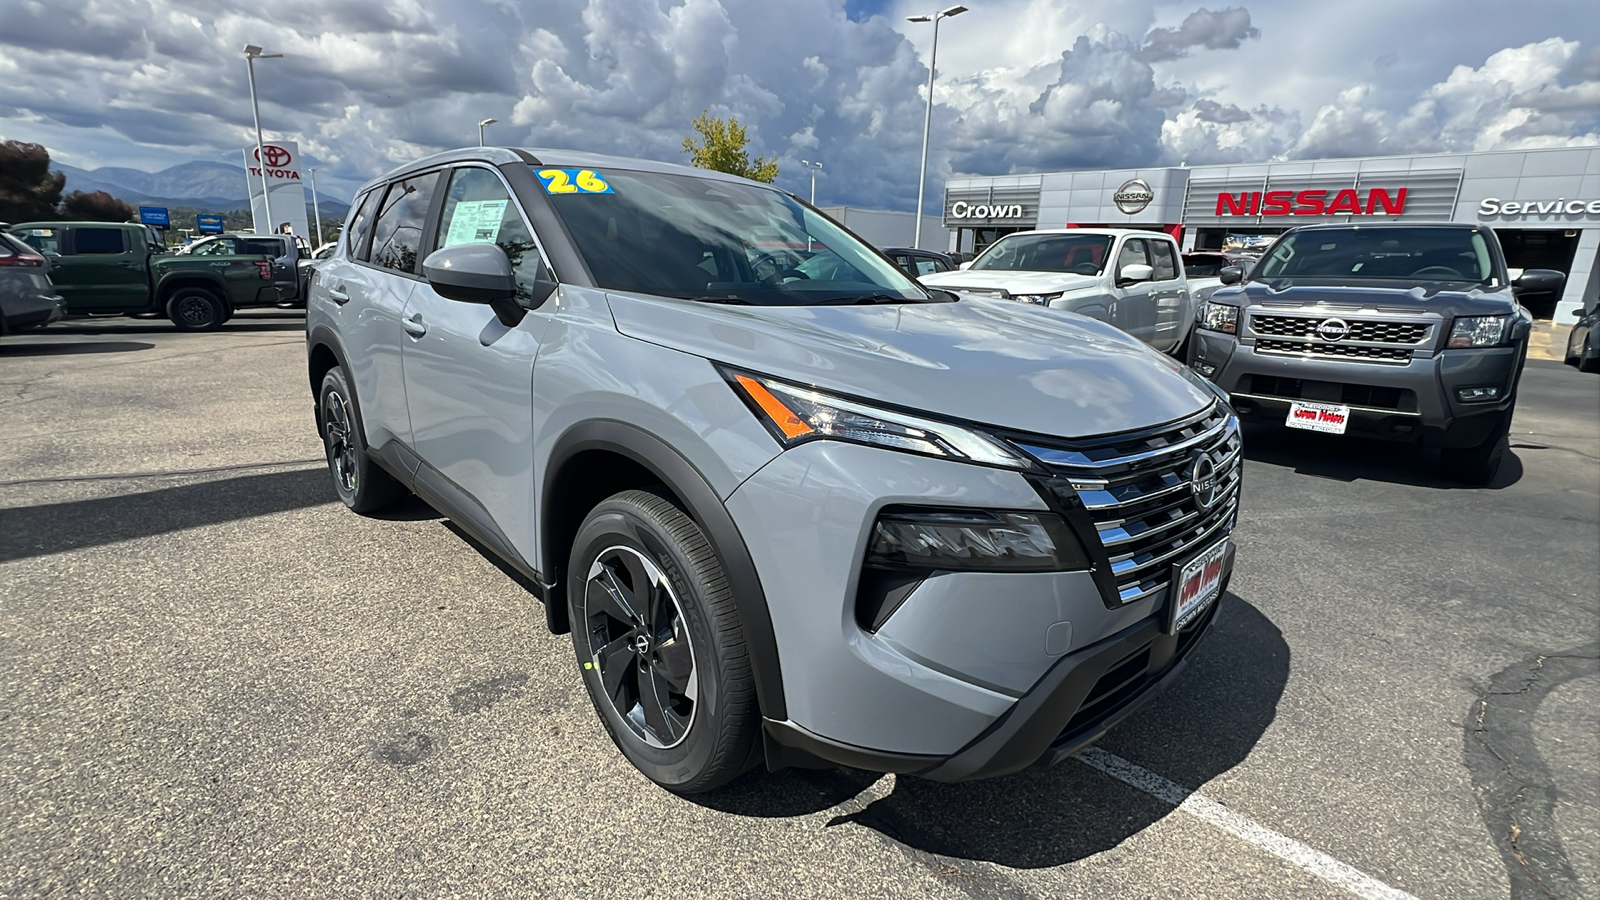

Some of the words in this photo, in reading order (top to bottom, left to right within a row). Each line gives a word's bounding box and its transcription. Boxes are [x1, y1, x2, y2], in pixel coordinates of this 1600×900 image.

[249, 167, 300, 180] TOYOTA
[538, 169, 608, 195] 26
[1116, 193, 1150, 201] NISSAN
[1215, 187, 1407, 216] NISSAN
[952, 201, 1022, 218] Crown
[1478, 197, 1600, 215] Service
[1192, 478, 1214, 493] NISS
